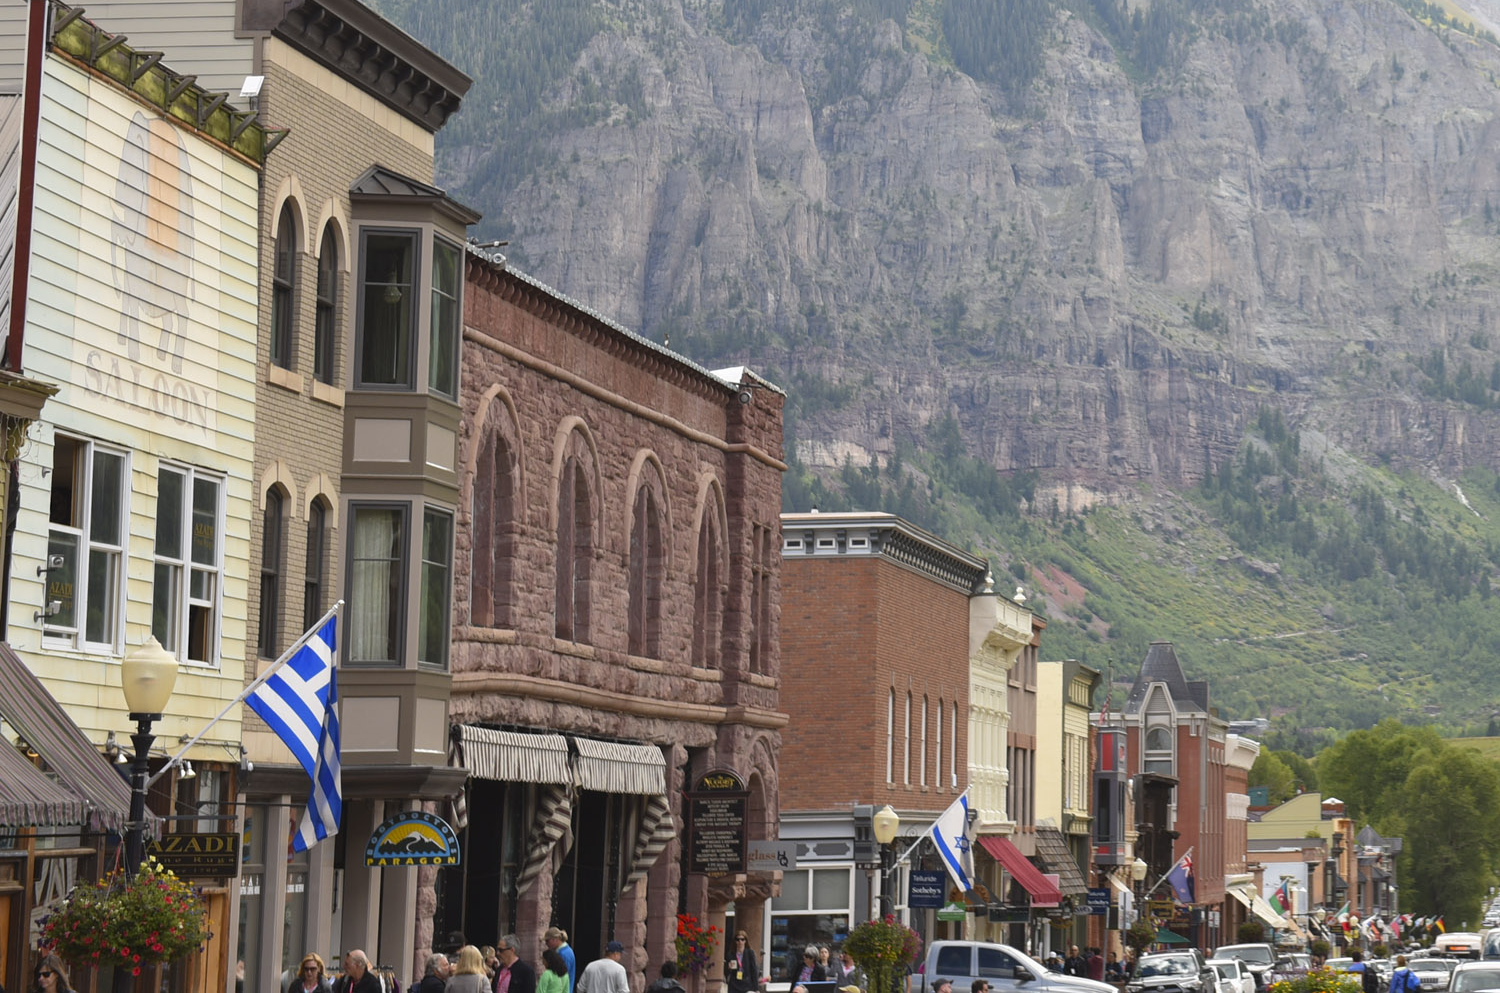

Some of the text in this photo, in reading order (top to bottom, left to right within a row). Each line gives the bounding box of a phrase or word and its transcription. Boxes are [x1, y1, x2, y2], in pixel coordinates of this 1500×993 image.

[83, 350, 210, 438] SALOON
[146, 836, 235, 853] AZADI
[366, 856, 456, 866] PARAGON
[748, 848, 776, 862] glass
[912, 875, 938, 883] Telluride
[911, 886, 942, 895] Sotheby's
